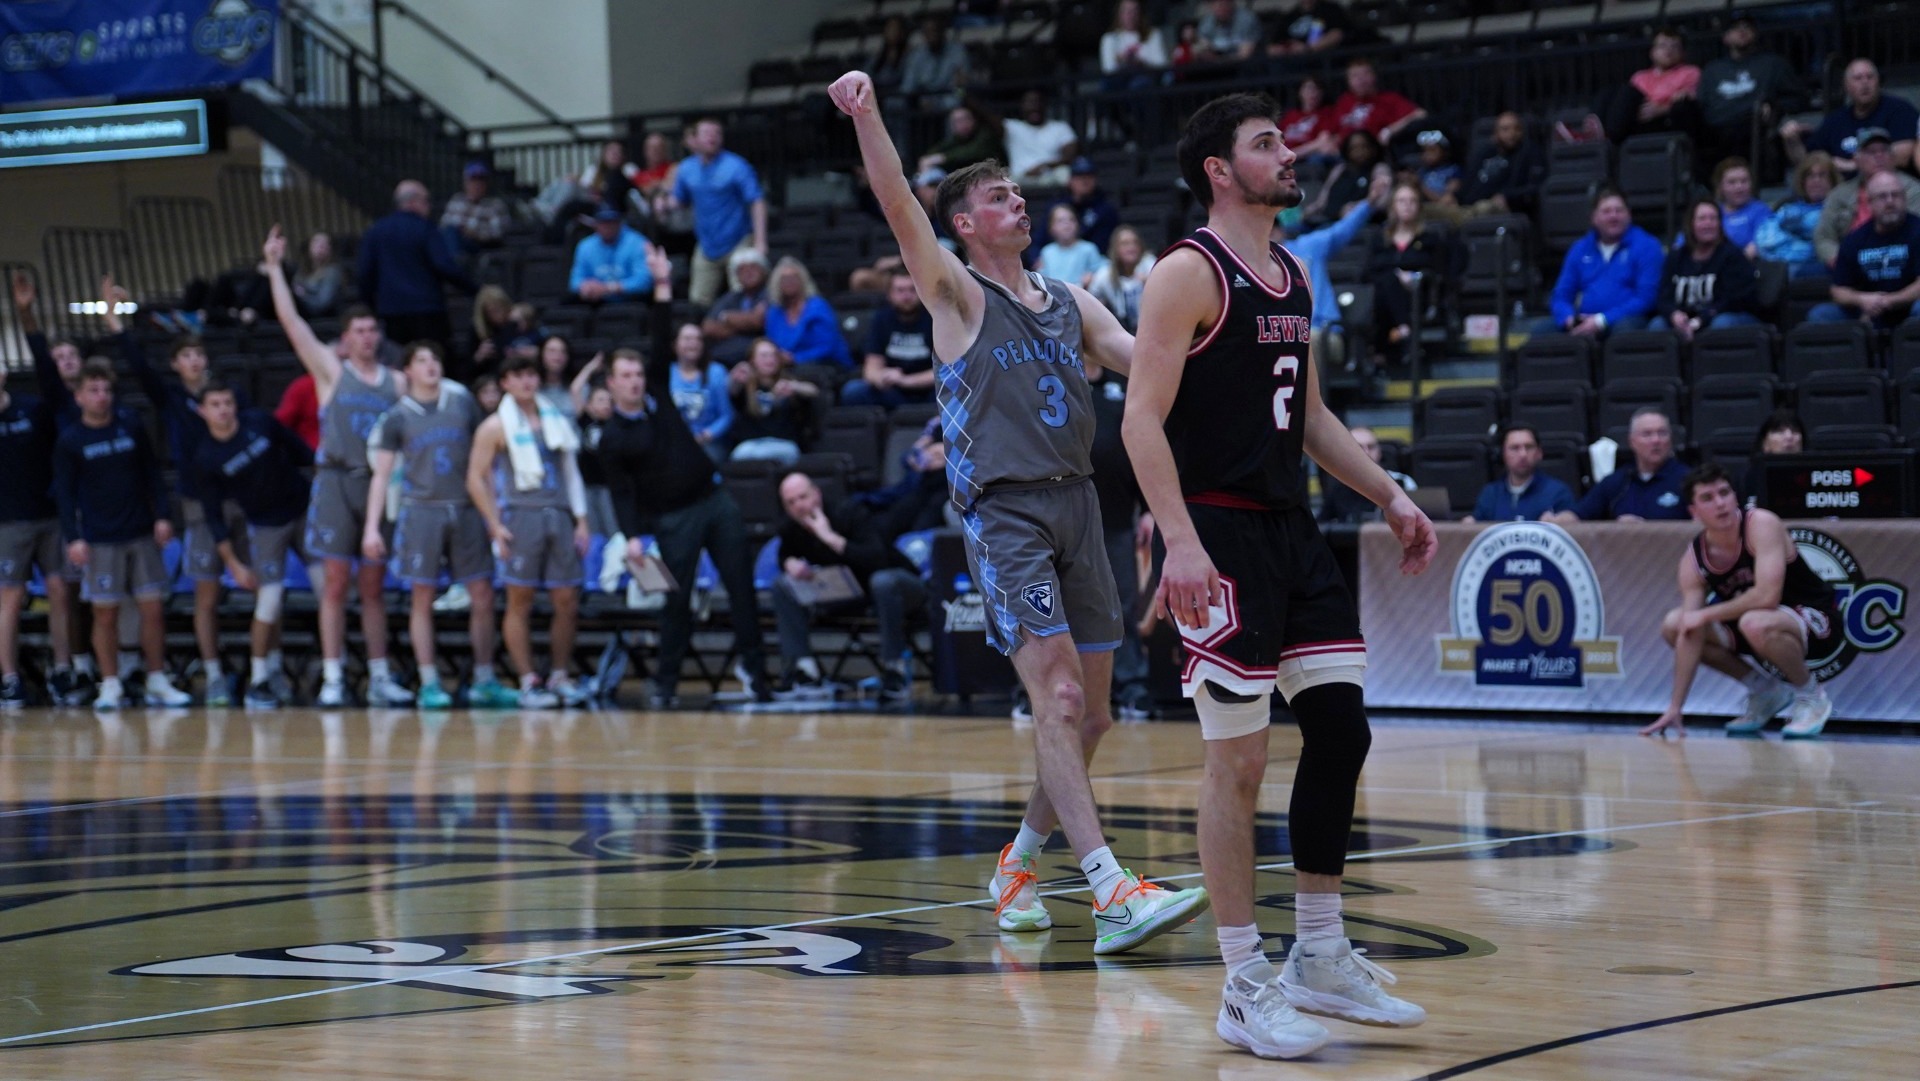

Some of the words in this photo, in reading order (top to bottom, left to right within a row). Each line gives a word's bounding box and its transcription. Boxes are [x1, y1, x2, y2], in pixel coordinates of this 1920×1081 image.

[99, 12, 187, 39] SPORTS
[1256, 315, 1311, 343] LEWIS
[991, 338, 1086, 379] PEACOCKS
[1037, 374, 1070, 428] 3
[1272, 355, 1299, 430] 2
[1811, 470, 1852, 487] POSS
[1805, 491, 1860, 508] BONUS
[1483, 532, 1552, 558] DIVISION
[1790, 529, 1814, 543] KES
[1816, 534, 1858, 573] VALLEY
[1504, 558, 1543, 576] NCAA
[1489, 578, 1564, 646] 50
[1482, 658, 1517, 673] MAKE
[1517, 657, 1530, 673] IT
